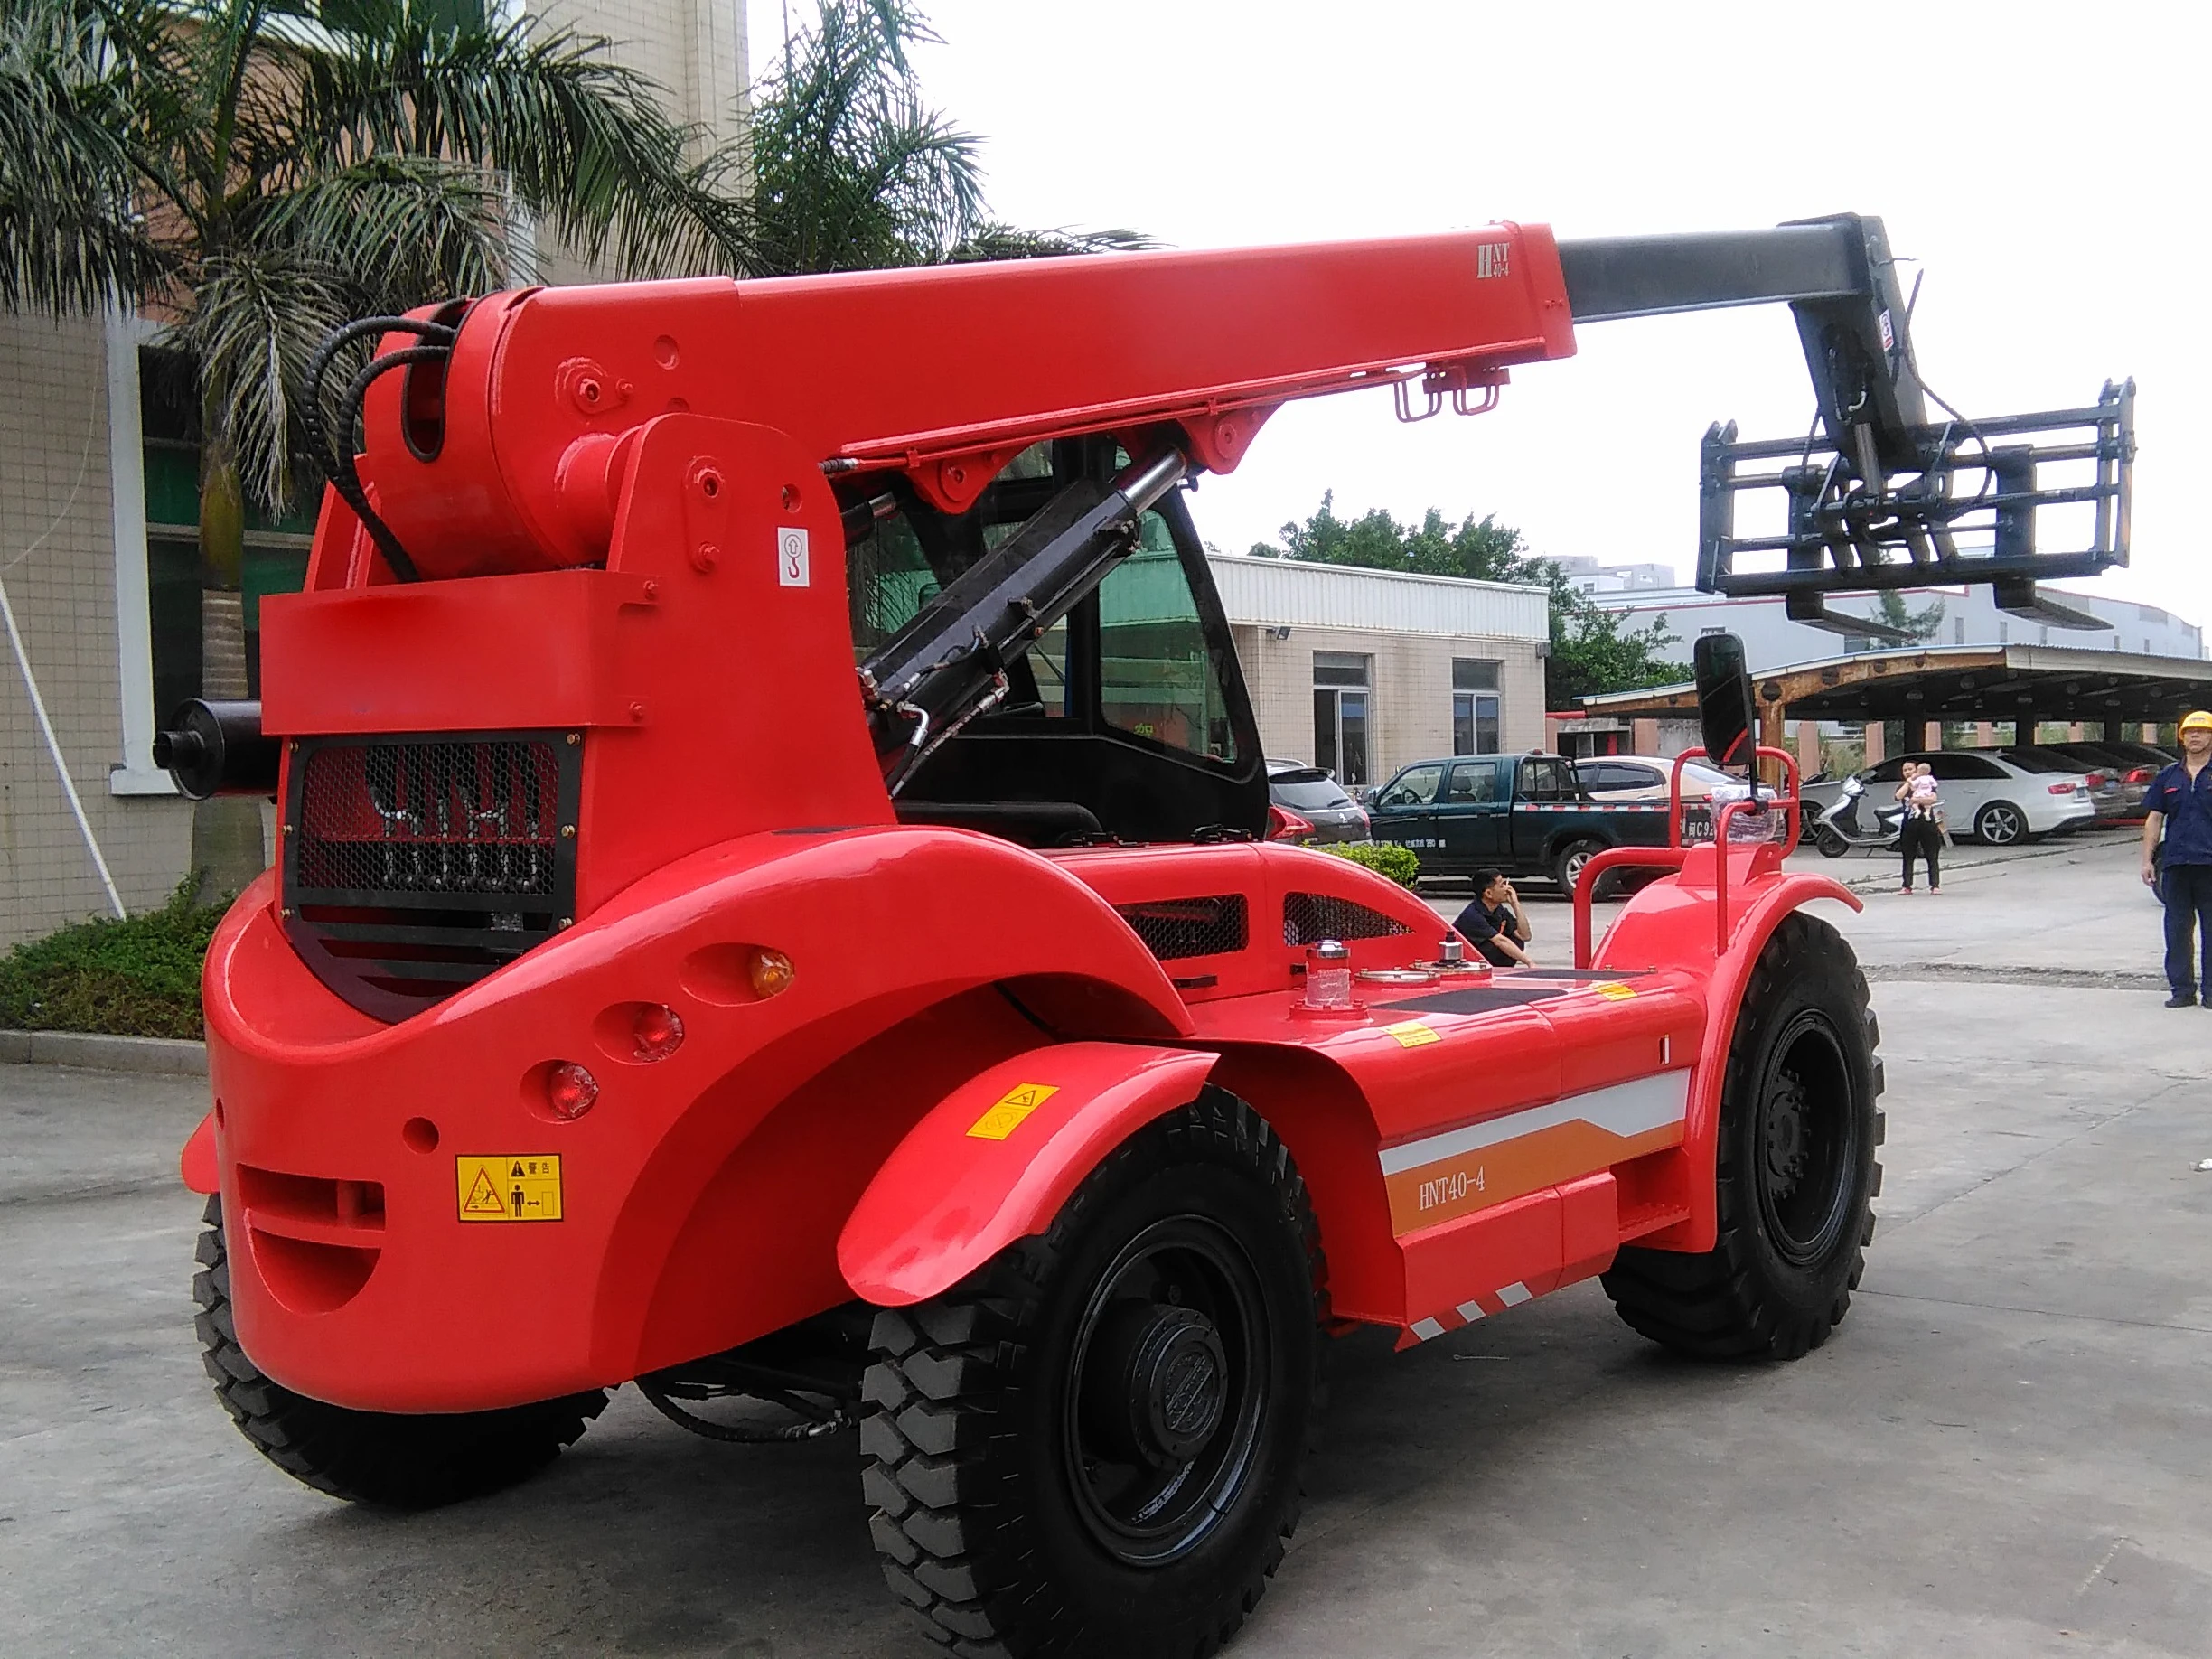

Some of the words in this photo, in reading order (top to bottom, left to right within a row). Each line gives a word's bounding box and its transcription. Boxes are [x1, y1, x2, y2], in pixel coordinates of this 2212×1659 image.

[1476, 242, 1510, 278] HNT
[1493, 262, 1509, 277] 40-4
[1419, 1165, 1486, 1211] HNT40-4
